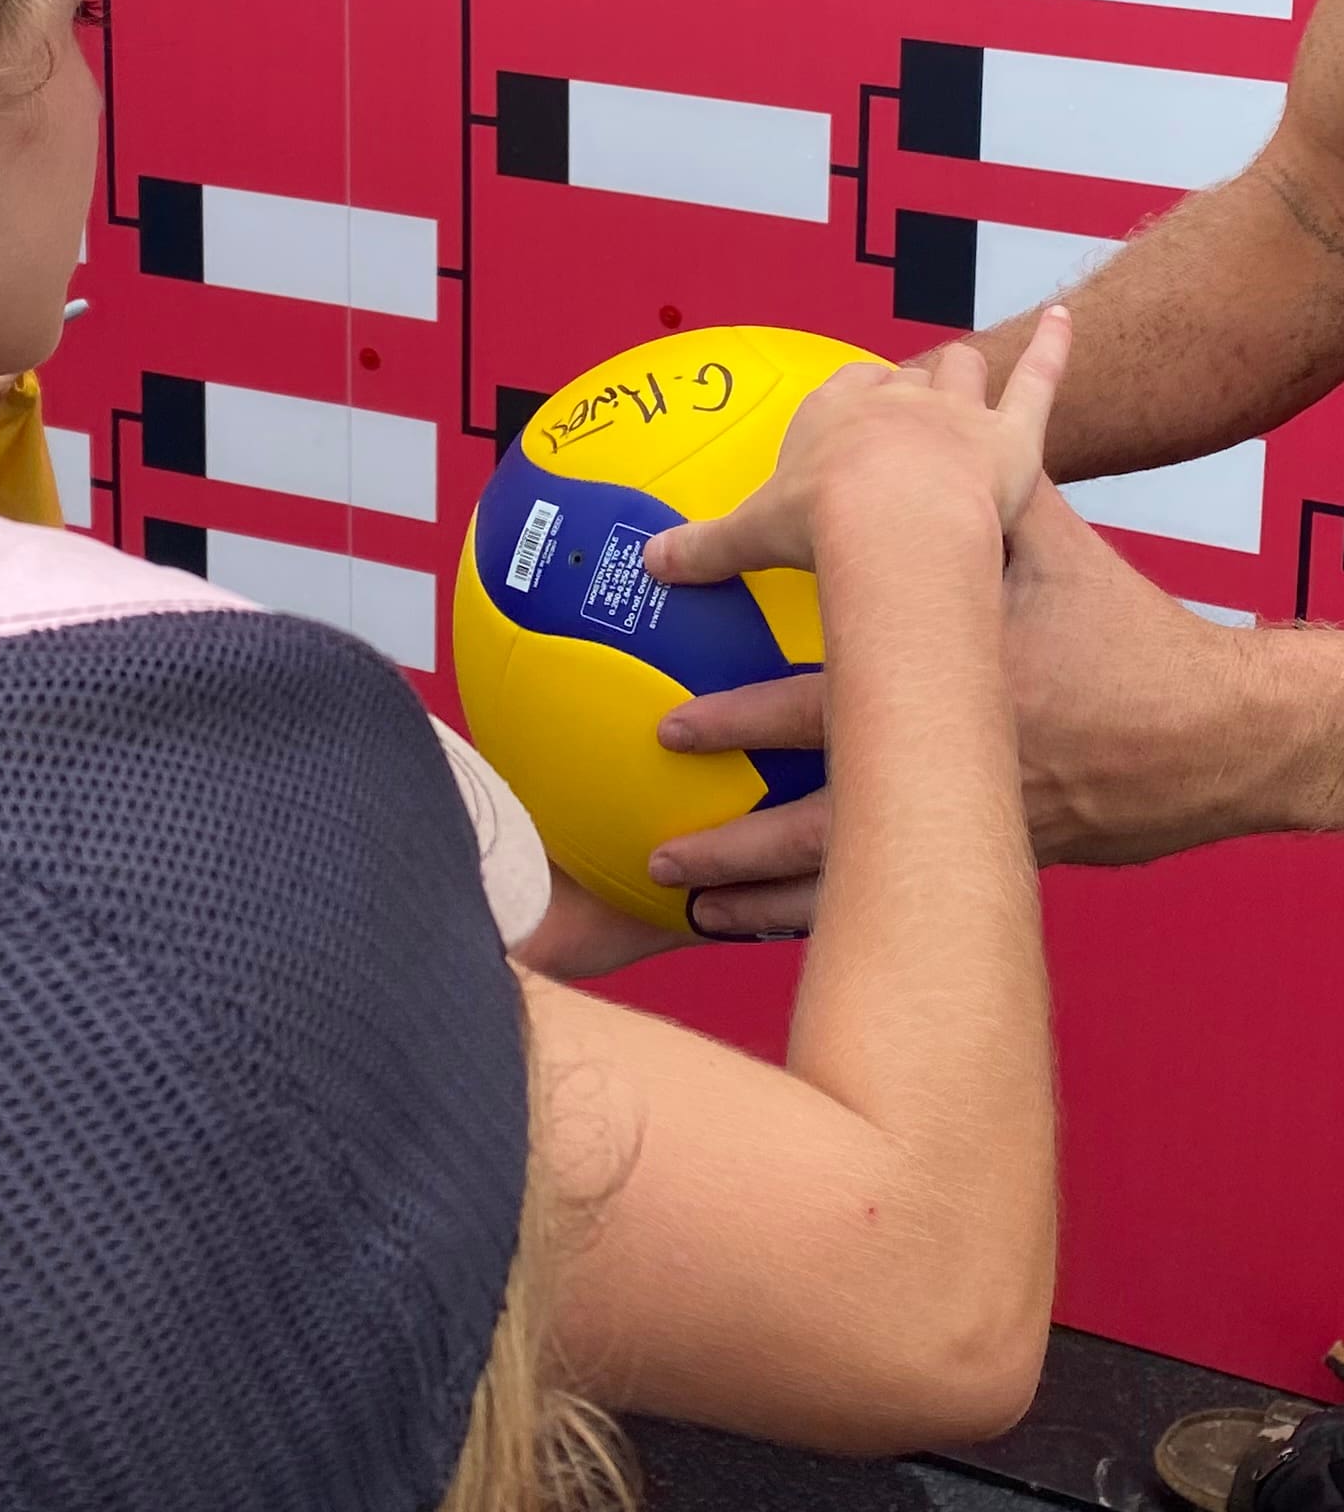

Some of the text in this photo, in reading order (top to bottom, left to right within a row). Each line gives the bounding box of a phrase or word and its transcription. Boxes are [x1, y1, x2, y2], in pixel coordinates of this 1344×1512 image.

[601, 535, 619, 567] NEEDLE
[611, 548, 621, 562] TO
[629, 594, 642, 611] not
[623, 611, 636, 628] Do
